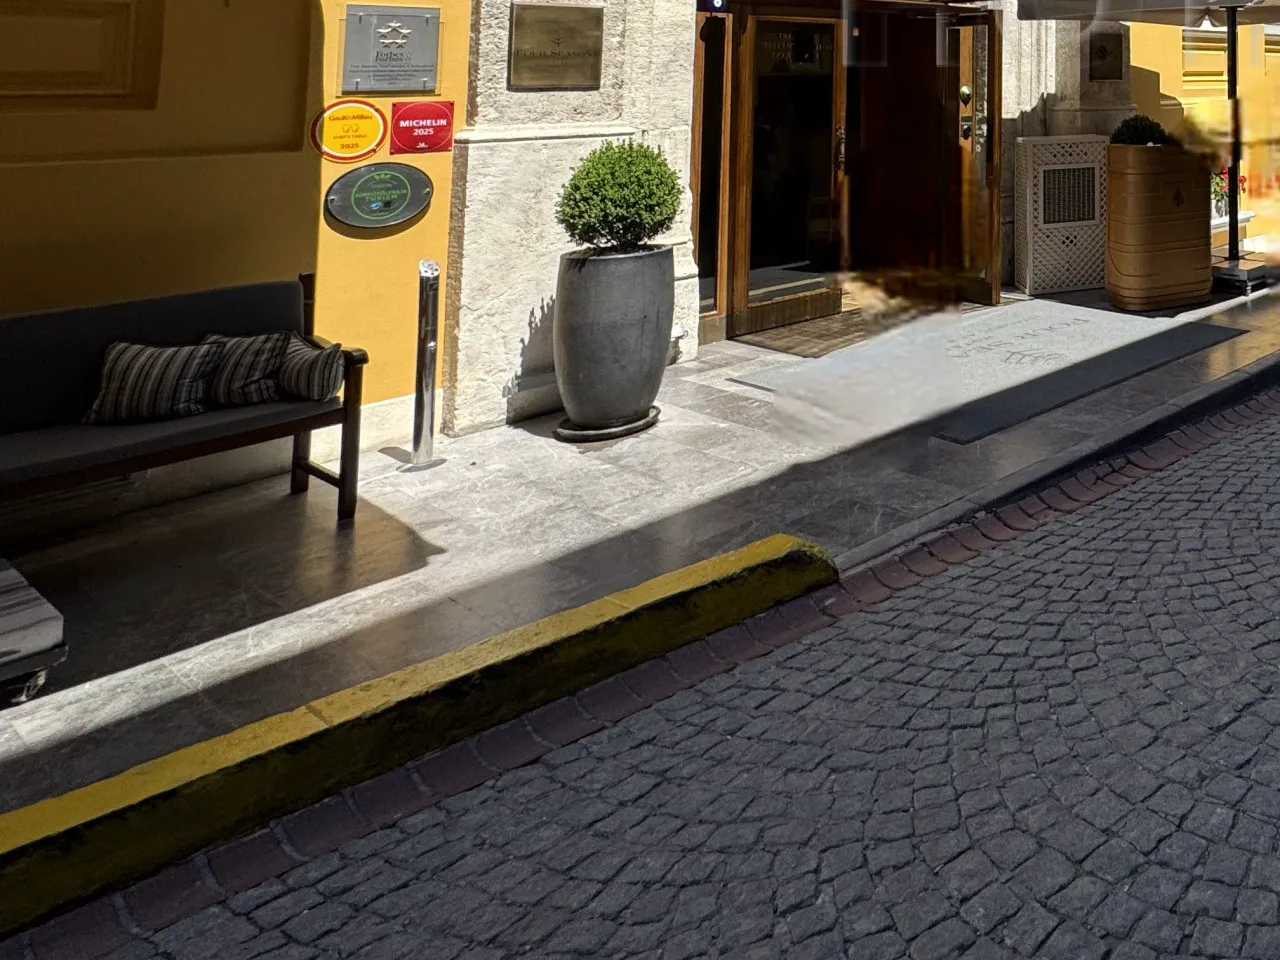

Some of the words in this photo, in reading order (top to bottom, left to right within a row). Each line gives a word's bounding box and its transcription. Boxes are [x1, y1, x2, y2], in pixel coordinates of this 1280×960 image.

[376, 50, 404, 59] Forbes
[400, 119, 447, 128] MICHELIN
[412, 128, 434, 136] 2025
